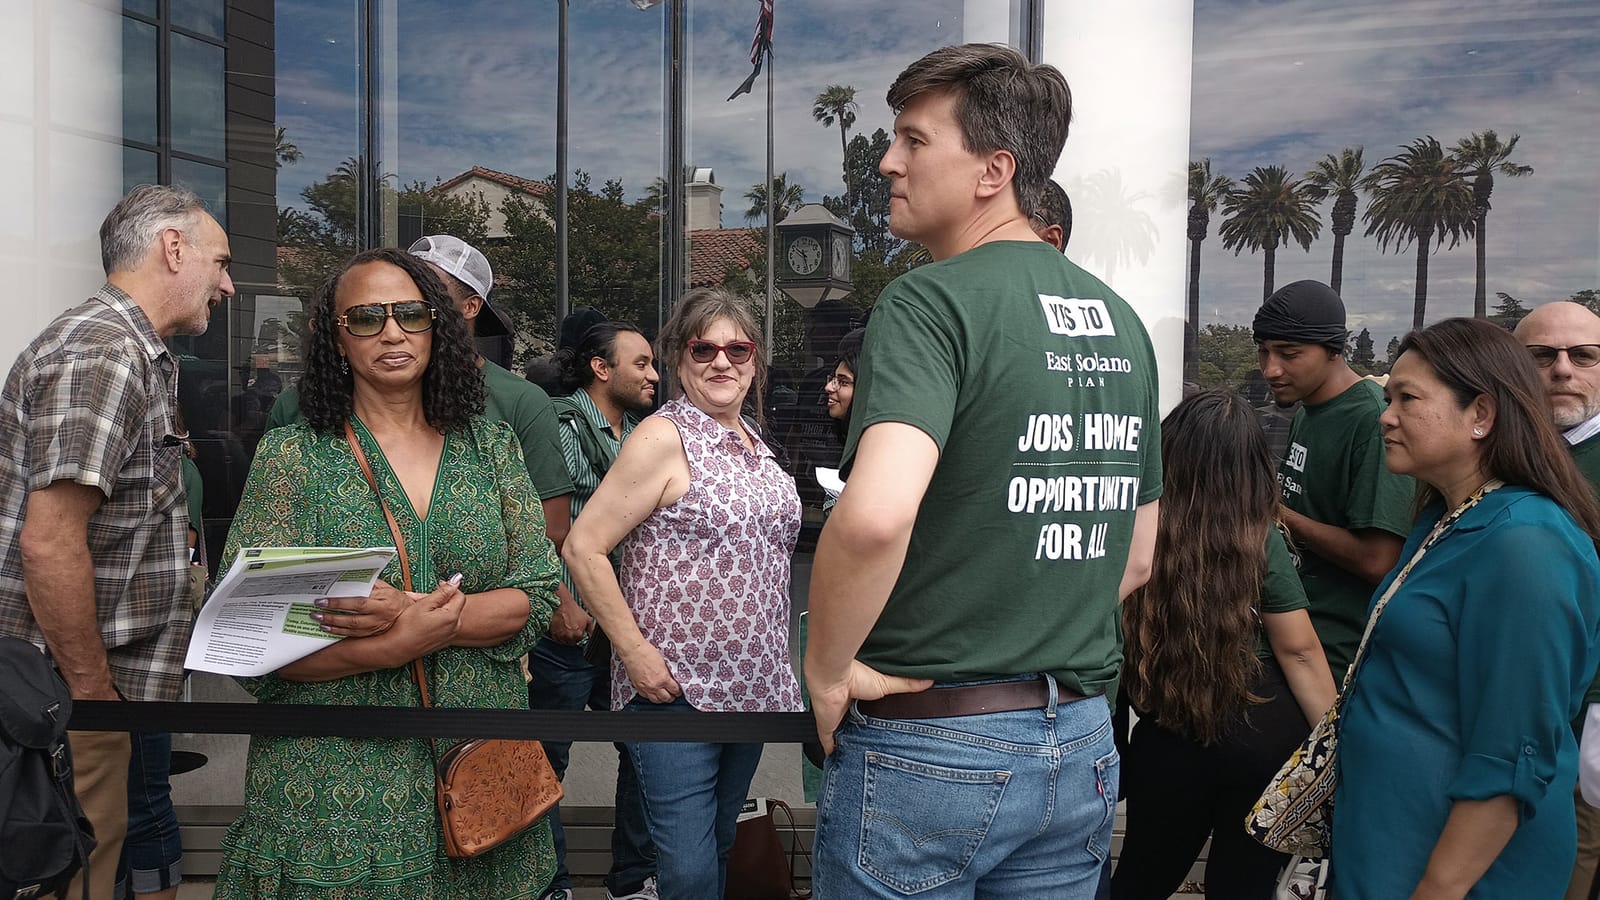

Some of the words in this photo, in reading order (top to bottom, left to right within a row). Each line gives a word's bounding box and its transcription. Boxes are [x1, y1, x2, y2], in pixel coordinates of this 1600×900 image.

[1049, 303, 1076, 330] YES
[1078, 306, 1103, 330] TO
[1045, 352, 1073, 372] East
[1075, 352, 1132, 373] Solano
[1067, 377, 1105, 388] PLAN
[1018, 414, 1073, 452] JOBS
[1084, 413, 1142, 452] HOME
[1007, 476, 1140, 514] OPPORTUNITY
[1034, 523, 1082, 560] FOR
[1086, 523, 1108, 559] ALL
